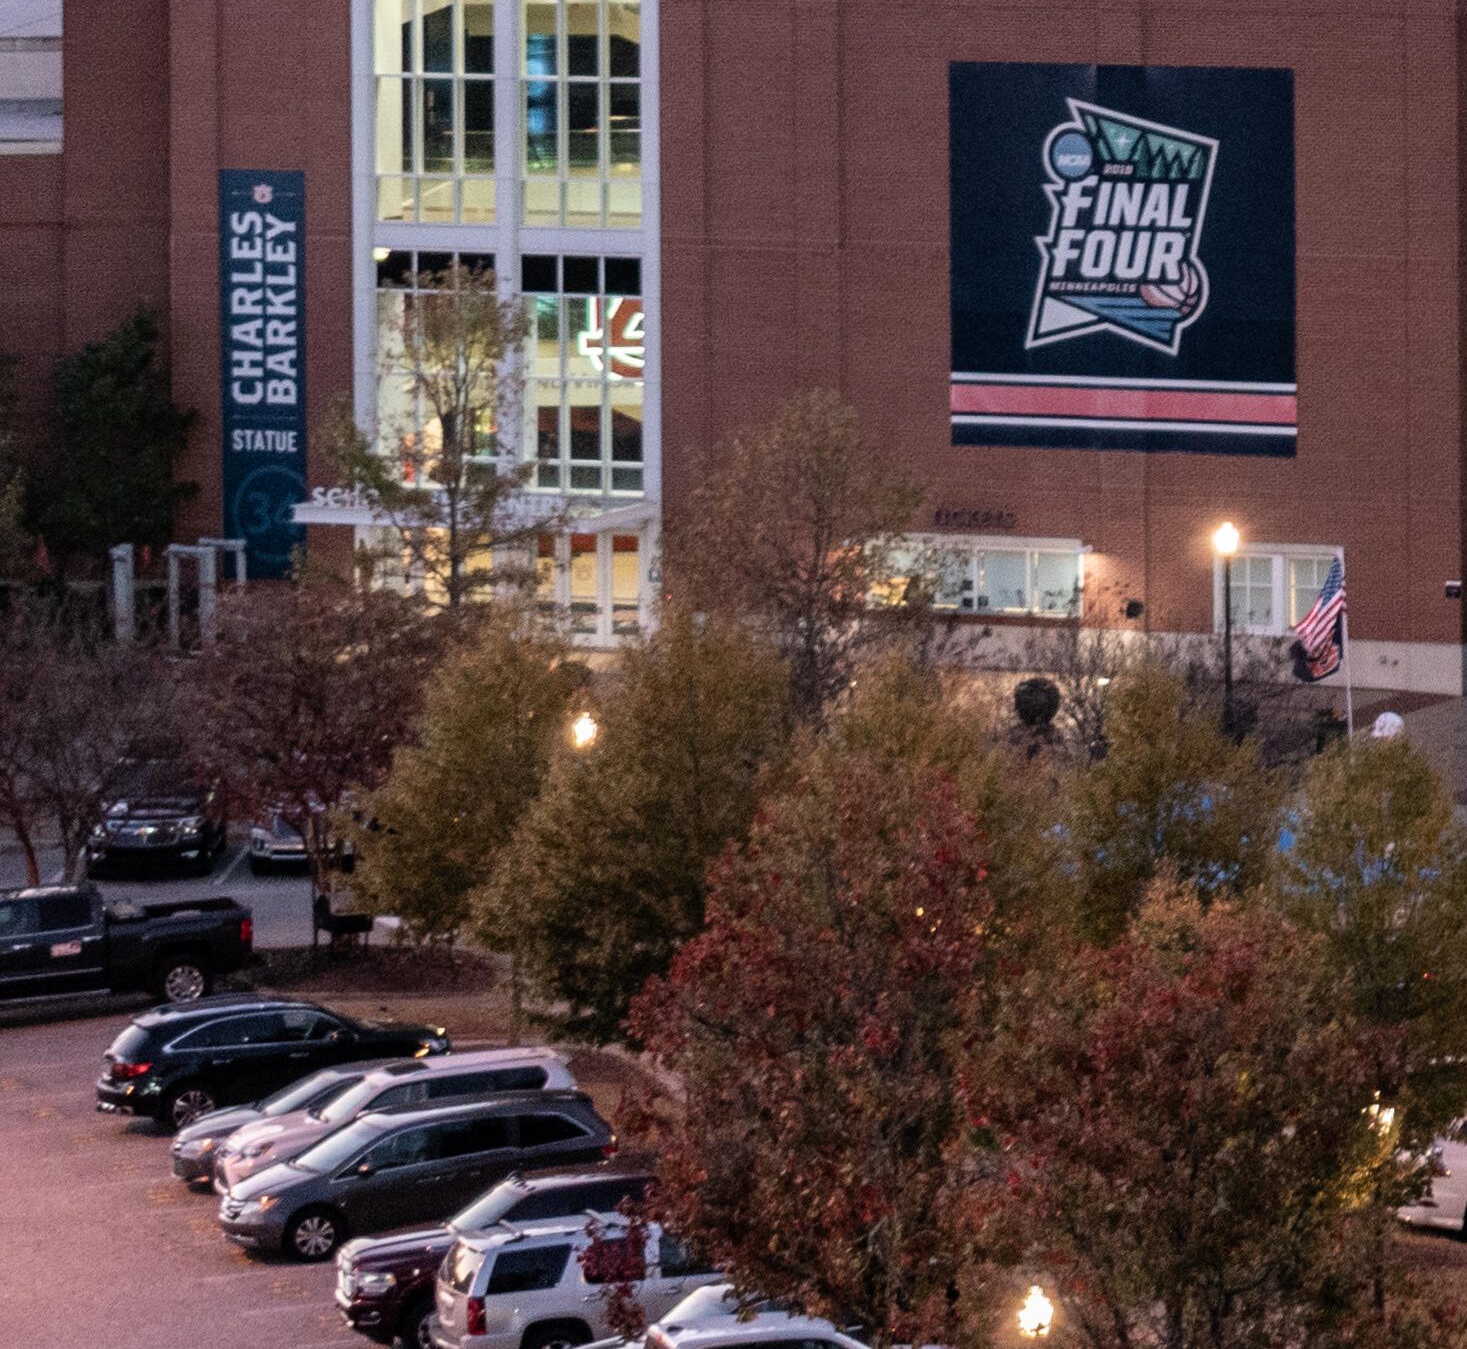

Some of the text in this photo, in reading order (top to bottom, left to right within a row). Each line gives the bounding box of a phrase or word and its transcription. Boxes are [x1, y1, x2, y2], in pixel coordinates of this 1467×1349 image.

[1061, 175, 1193, 228] FINAL
[1051, 229, 1187, 280] FOUR
[230, 211, 265, 405] CHARLES
[265, 213, 298, 405] BARKLEY
[1049, 281, 1138, 293] MINNEAPOLIS
[231, 429, 299, 452] STATUE
